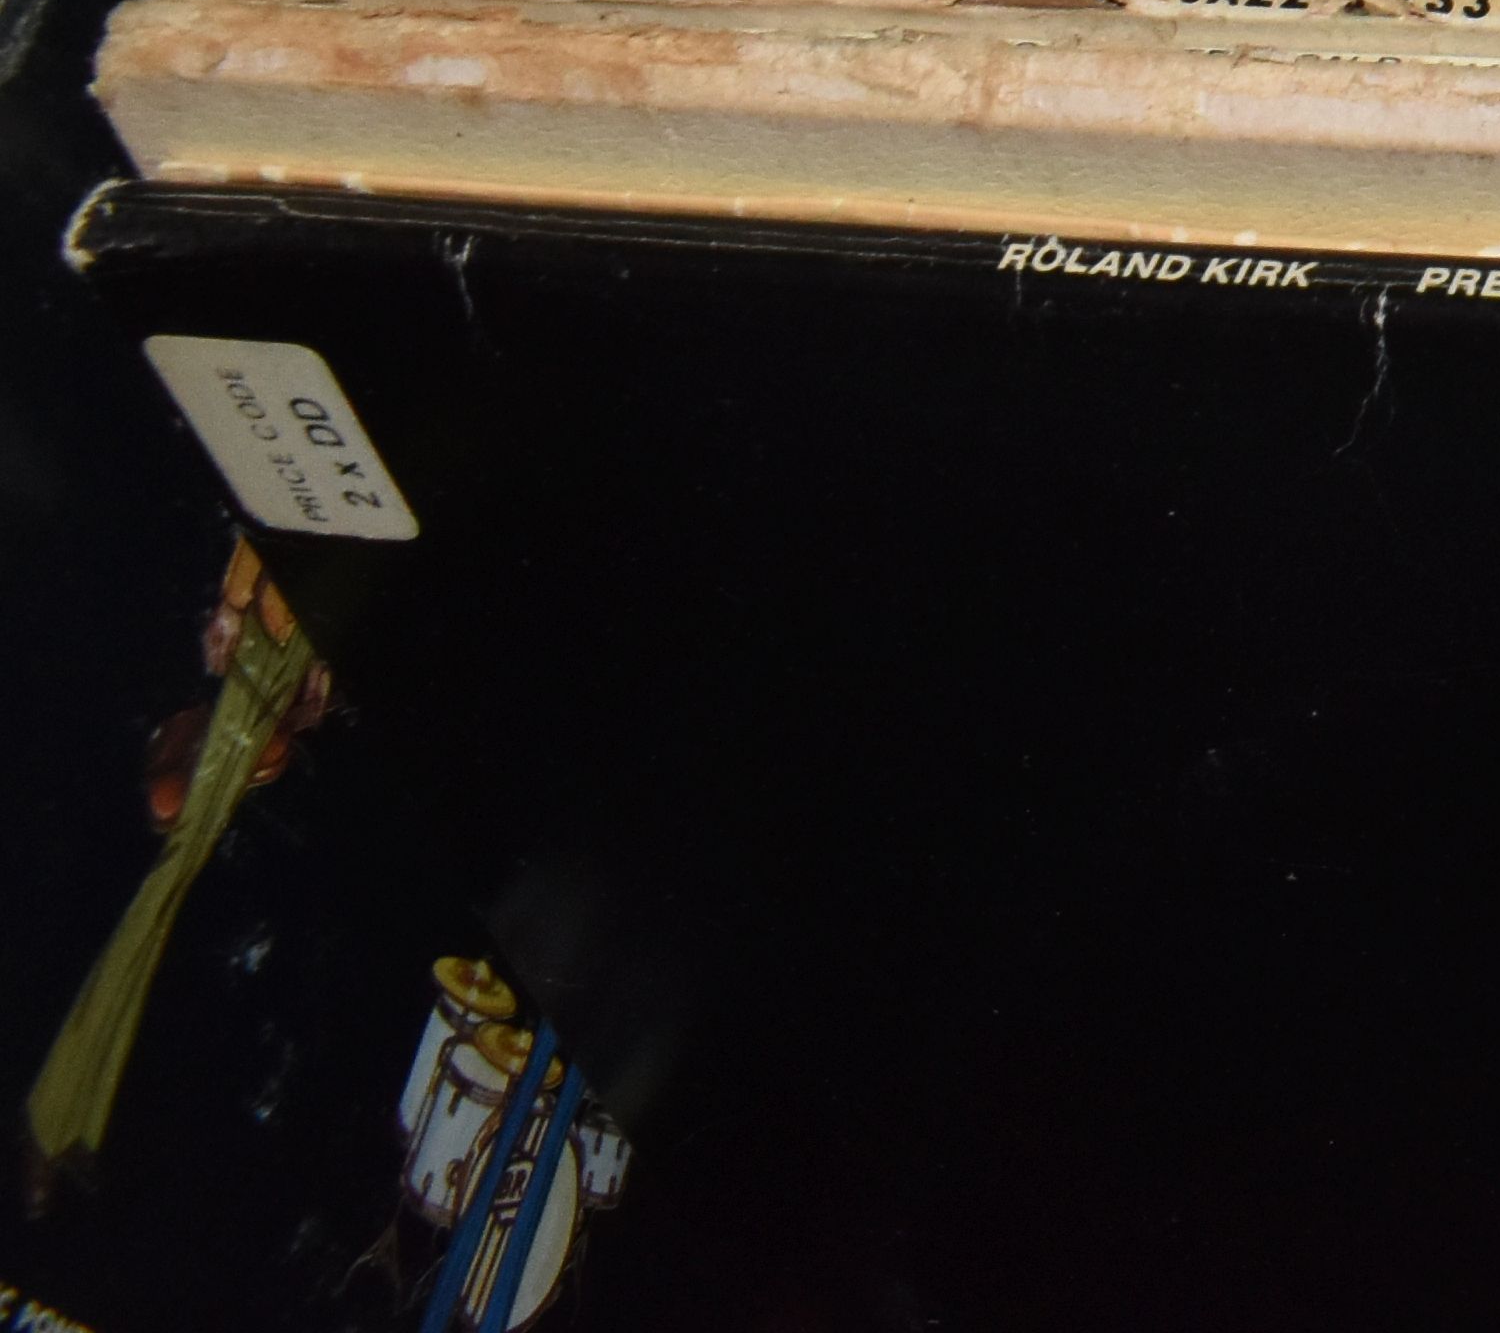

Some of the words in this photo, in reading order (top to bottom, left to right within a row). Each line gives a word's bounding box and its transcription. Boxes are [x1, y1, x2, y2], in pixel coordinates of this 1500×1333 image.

[997, 241, 1192, 282] ROLAND
[1200, 255, 1317, 289] KIRK
[217, 364, 278, 444] CODE
[270, 455, 330, 524] PRICE
